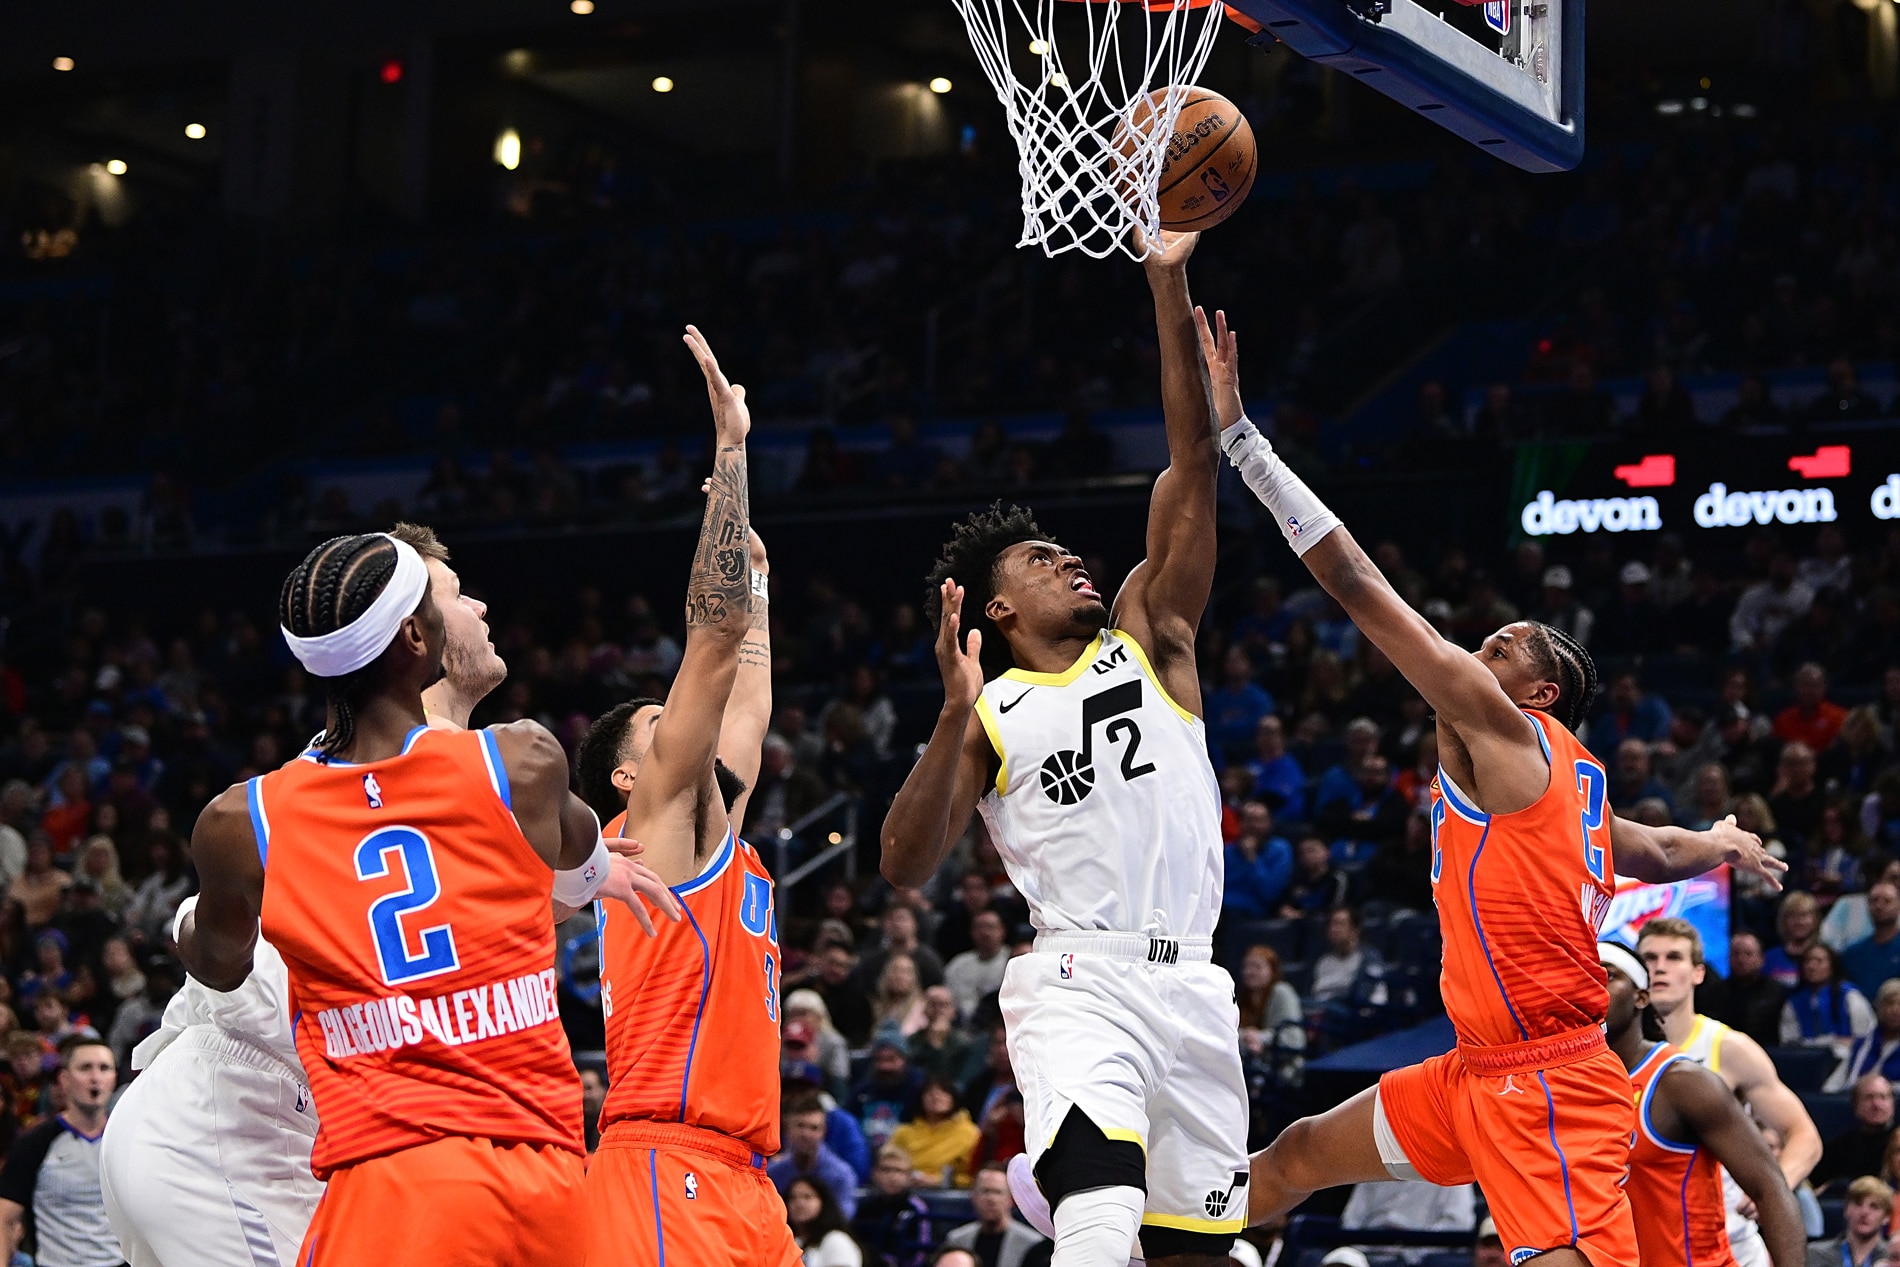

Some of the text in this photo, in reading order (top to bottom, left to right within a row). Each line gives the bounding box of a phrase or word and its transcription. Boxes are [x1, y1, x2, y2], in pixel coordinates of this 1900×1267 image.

[1522, 490, 1662, 536] devon
[1694, 483, 1838, 528] devon
[1106, 717, 1157, 782] 2
[353, 824, 461, 986] 2
[1148, 938, 1179, 965] UTAH
